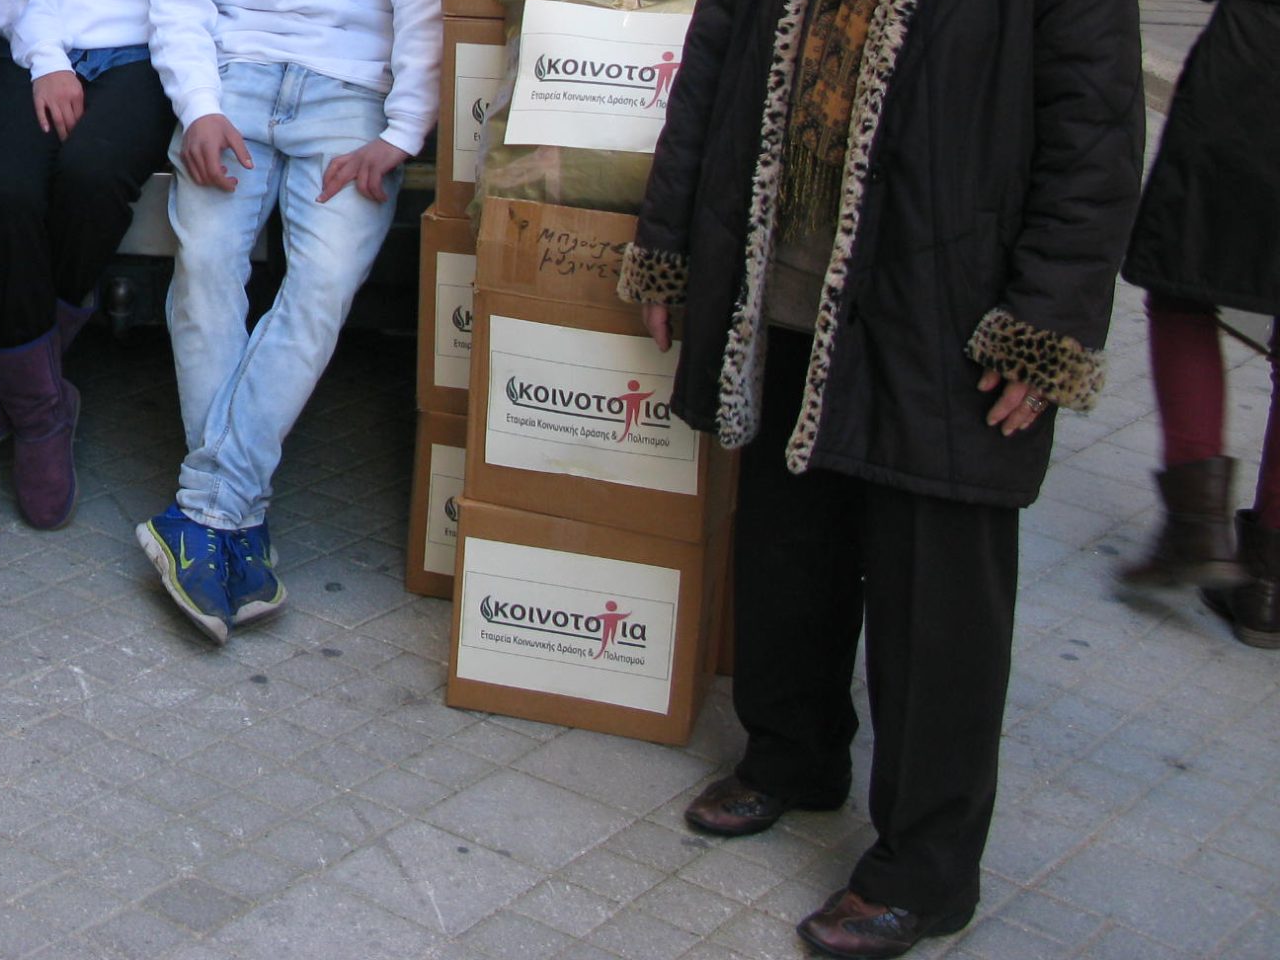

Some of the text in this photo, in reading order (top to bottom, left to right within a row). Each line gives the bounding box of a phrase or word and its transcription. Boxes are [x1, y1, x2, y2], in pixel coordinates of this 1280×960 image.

[531, 90, 561, 102] Εταιρεία
[562, 91, 606, 105] Κοινωνικής
[606, 95, 638, 108] Δράσης
[639, 96, 646, 106] &
[506, 413, 670, 447] Εταιρεία Κοινωνικής Δράσης & Πολιτισμού
[480, 629, 645, 666] Εταιρεία Κοινωνικής Δράσης & Πολιτισμού
